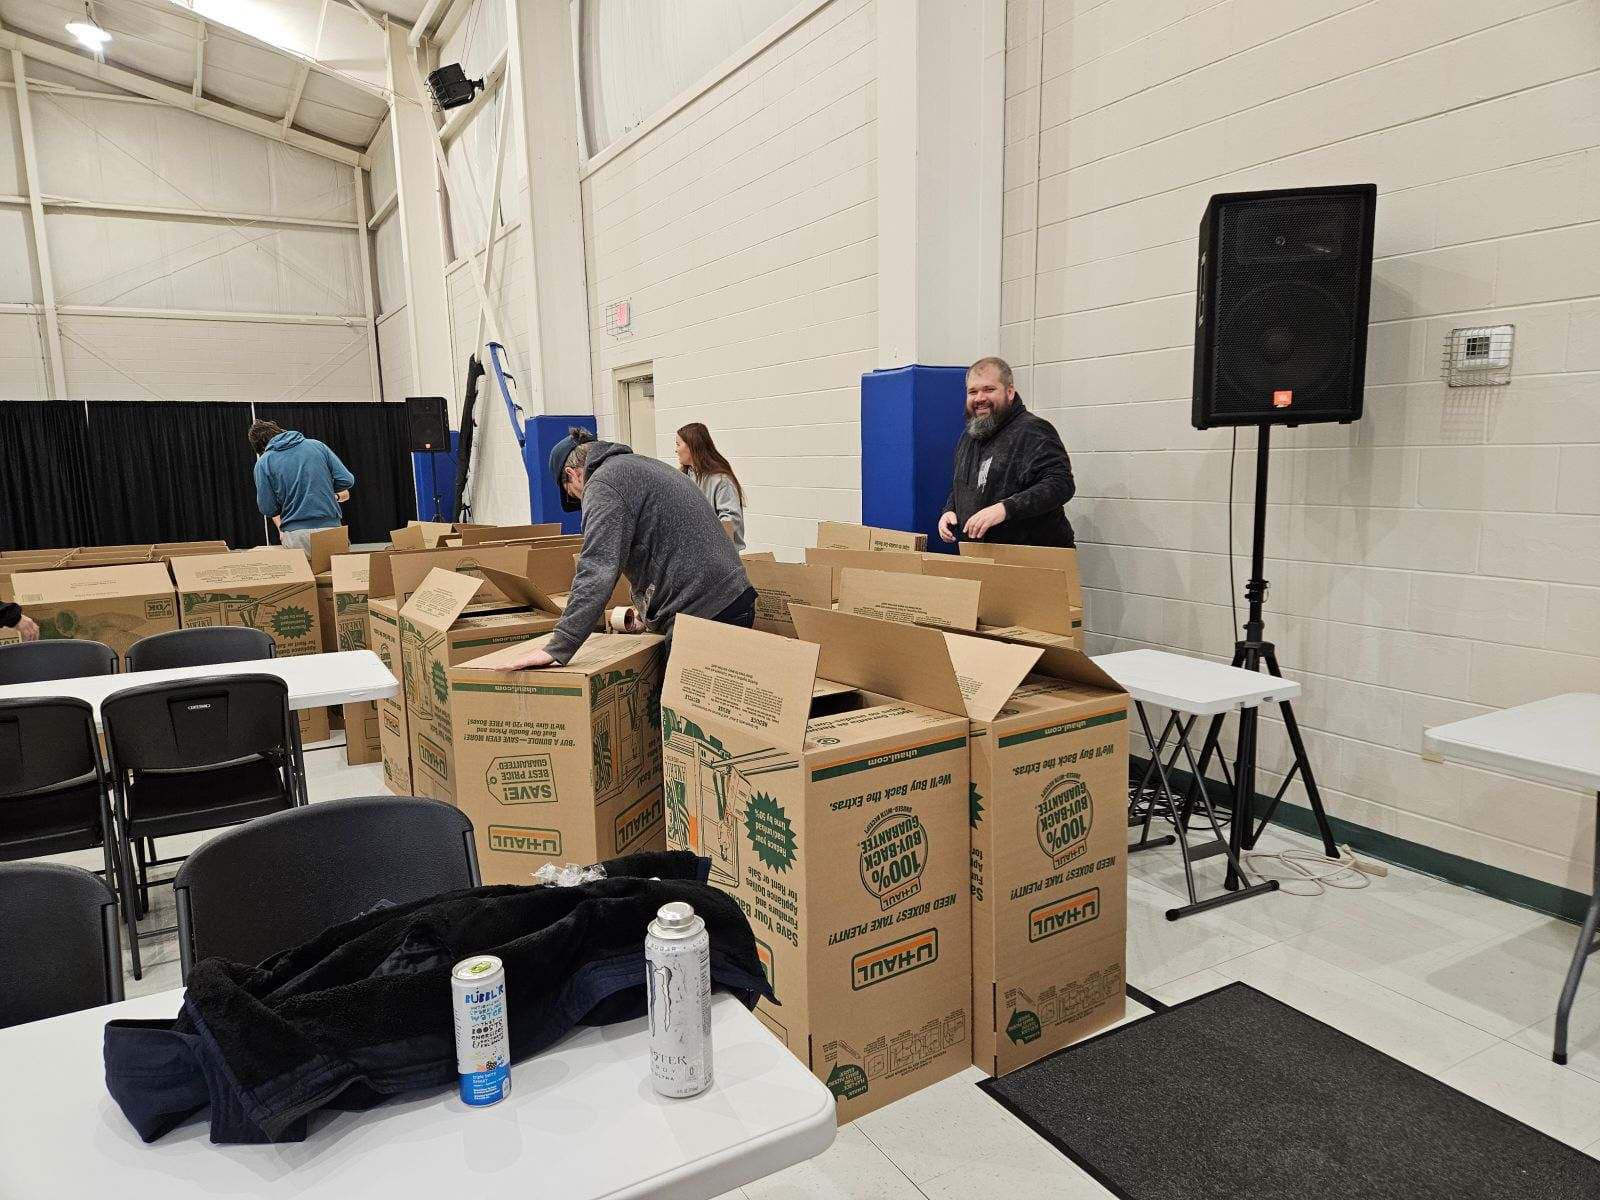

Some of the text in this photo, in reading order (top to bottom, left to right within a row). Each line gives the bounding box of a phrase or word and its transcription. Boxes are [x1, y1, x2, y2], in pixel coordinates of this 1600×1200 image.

[494, 685, 537, 694] uhaul.com
[489, 727, 508, 735] Prices
[508, 728, 530, 736] Bundle
[542, 730, 556, 738] Beat
[750, 716, 768, 728] REDUCE
[1044, 720, 1086, 735] uhaul.com
[464, 734, 484, 742] MORE!
[868, 749, 918, 766] uhaul.com
[1012, 744, 1114, 776] We'll Buy Back the Extras.
[500, 768, 549, 780] BEST PRICE
[502, 784, 552, 800] SAVE!
[829, 774, 952, 812] We'll Buy Back the Extras.
[1037, 782, 1086, 816] GUARANTEE
[618, 800, 660, 844] U-HAUL
[1040, 795, 1088, 832] BUY-BACK
[492, 836, 557, 852] U-HAUL
[860, 815, 920, 854] GUARANTEE
[1046, 815, 1087, 852] 100%
[767, 840, 786, 858] Reduce
[863, 830, 922, 872] BUY-BACK
[1055, 845, 1085, 868] U-HAUL
[748, 866, 798, 902] for Rent or Sale
[871, 850, 921, 893] 100%
[1010, 856, 1116, 900] NEED BOXES? TAKE PLENTY!
[745, 878, 798, 916] Appliance Dollies
[882, 883, 918, 908] U-HAUL
[754, 908, 774, 933] Your
[755, 896, 798, 930] Furniture and
[828, 893, 956, 946] NEED BOXES? TAKE PLENTY!
[1034, 901, 1096, 935] U-HAUL
[776, 922, 798, 948] Save
[857, 943, 933, 982] U-HAUL
